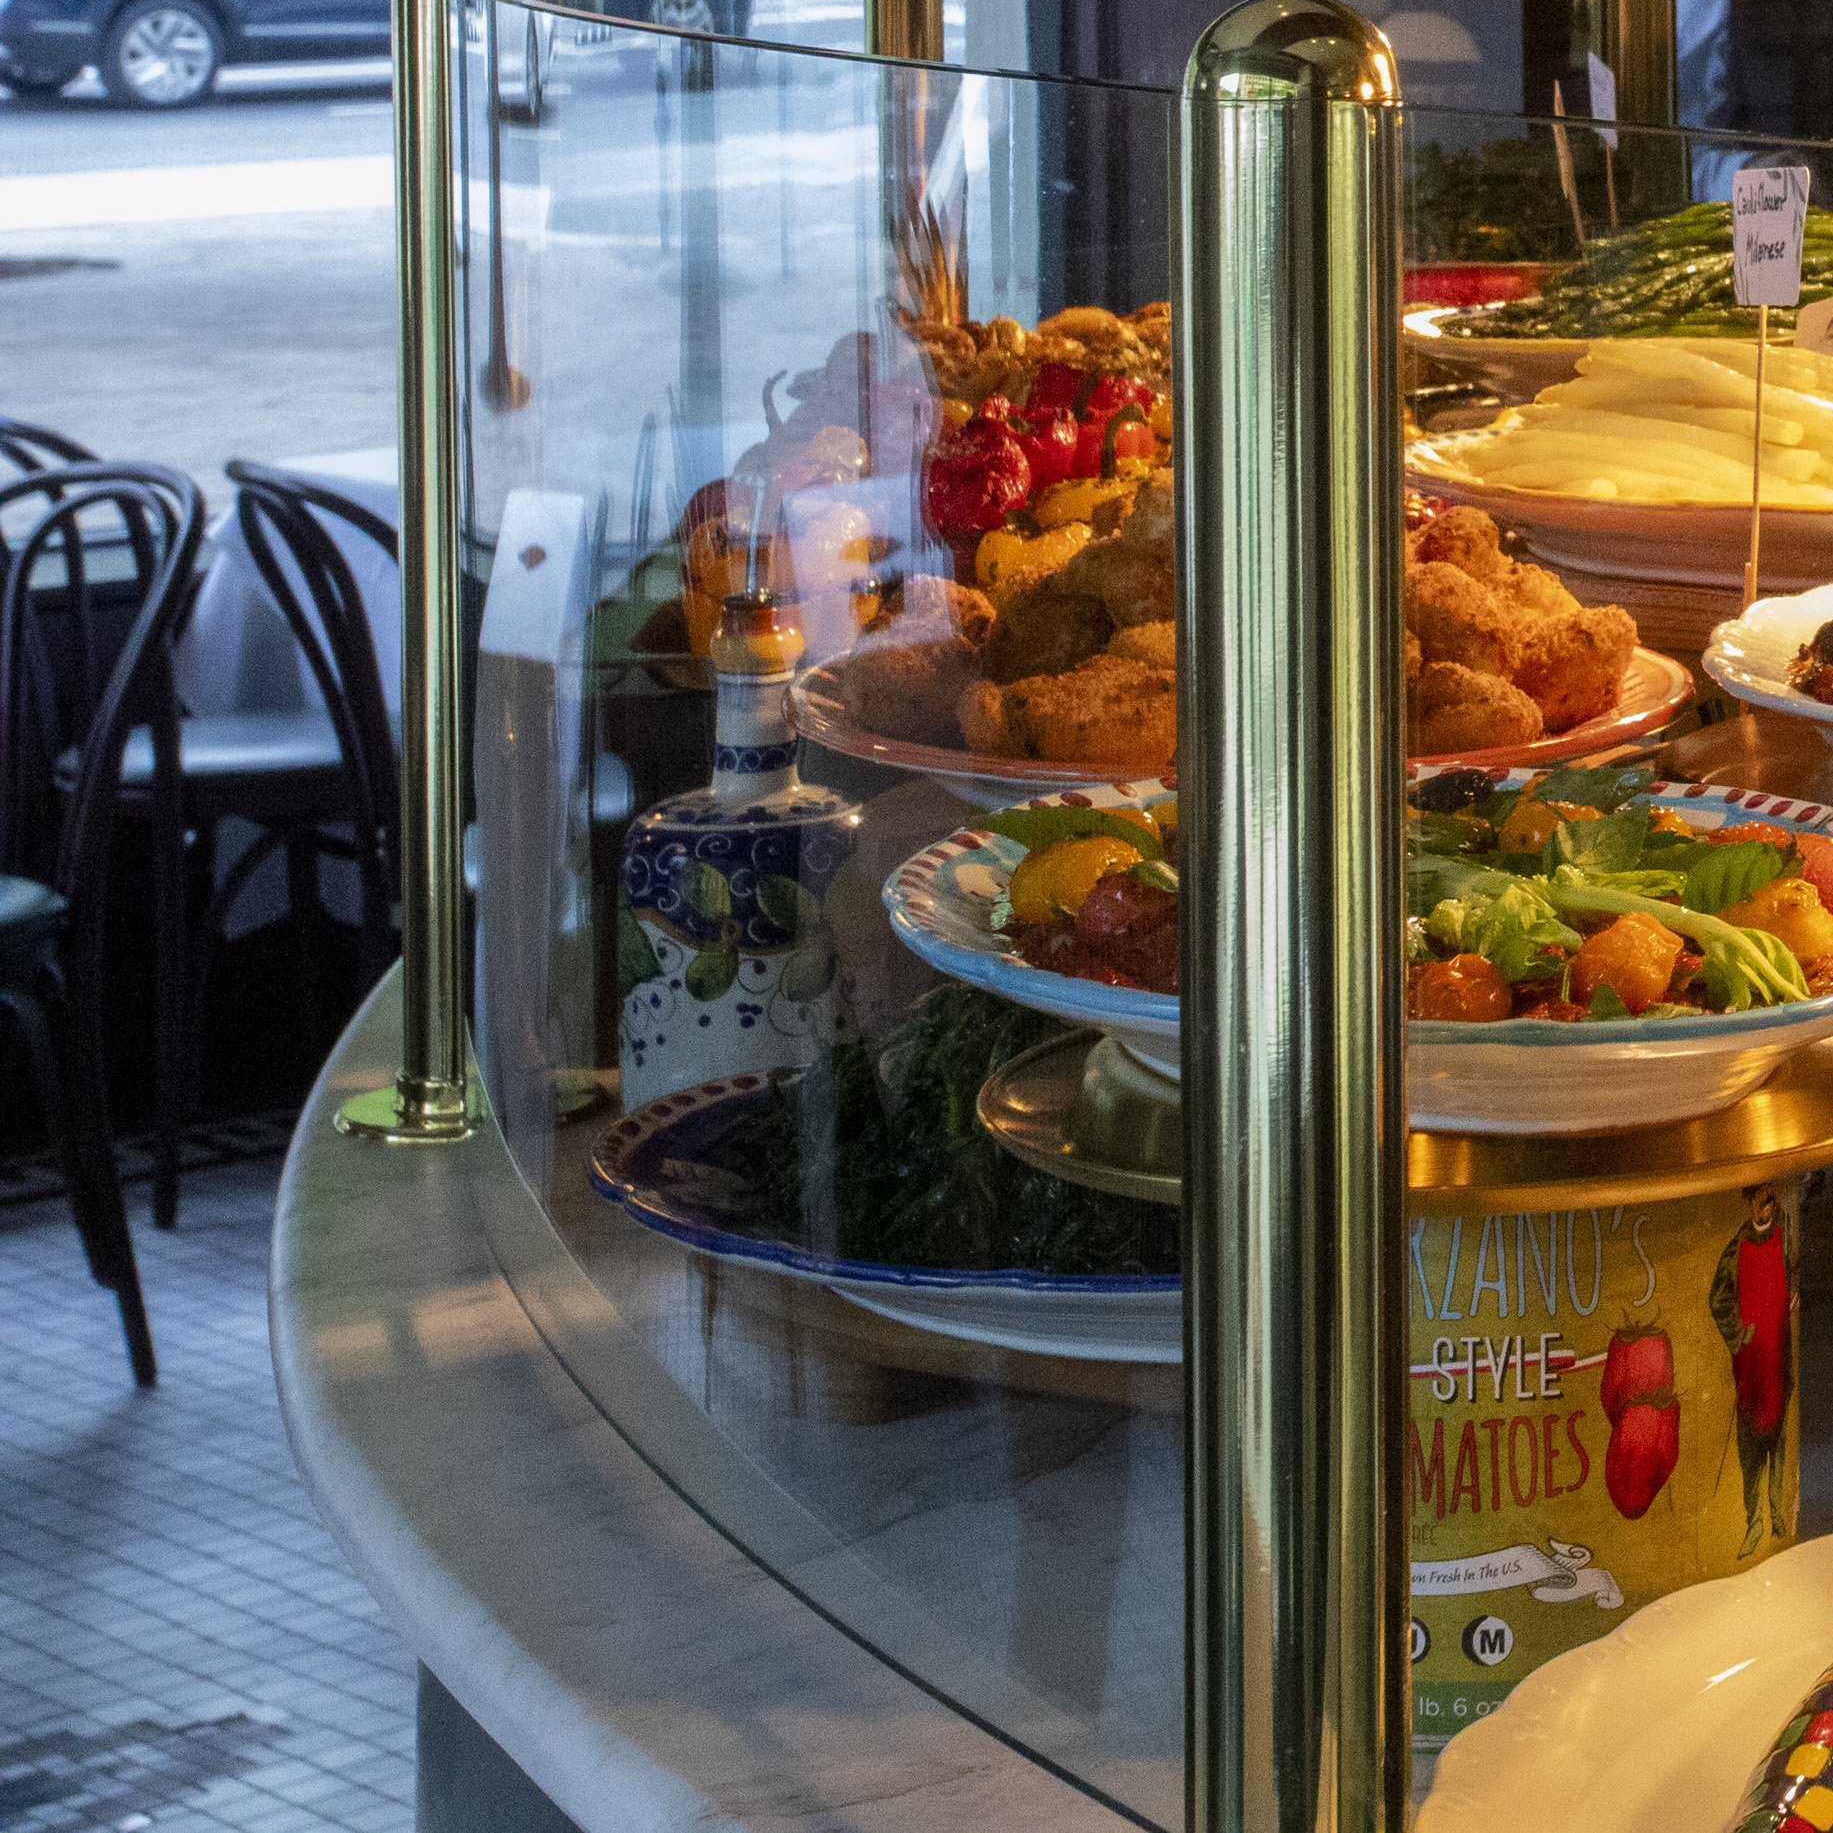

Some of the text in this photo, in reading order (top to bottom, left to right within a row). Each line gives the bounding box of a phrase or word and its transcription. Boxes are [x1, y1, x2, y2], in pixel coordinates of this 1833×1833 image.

[1432, 1331, 1563, 1403] STYLE
[1429, 1567, 1460, 1584] Fresh
[1464, 1568, 1476, 1582] In
[1480, 1563, 1499, 1579] The
[1502, 1559, 1523, 1576] U.S.
[1479, 1628, 1506, 1655] M
[1419, 1697, 1445, 1717] lb.
[1453, 1697, 1468, 1717] 6
